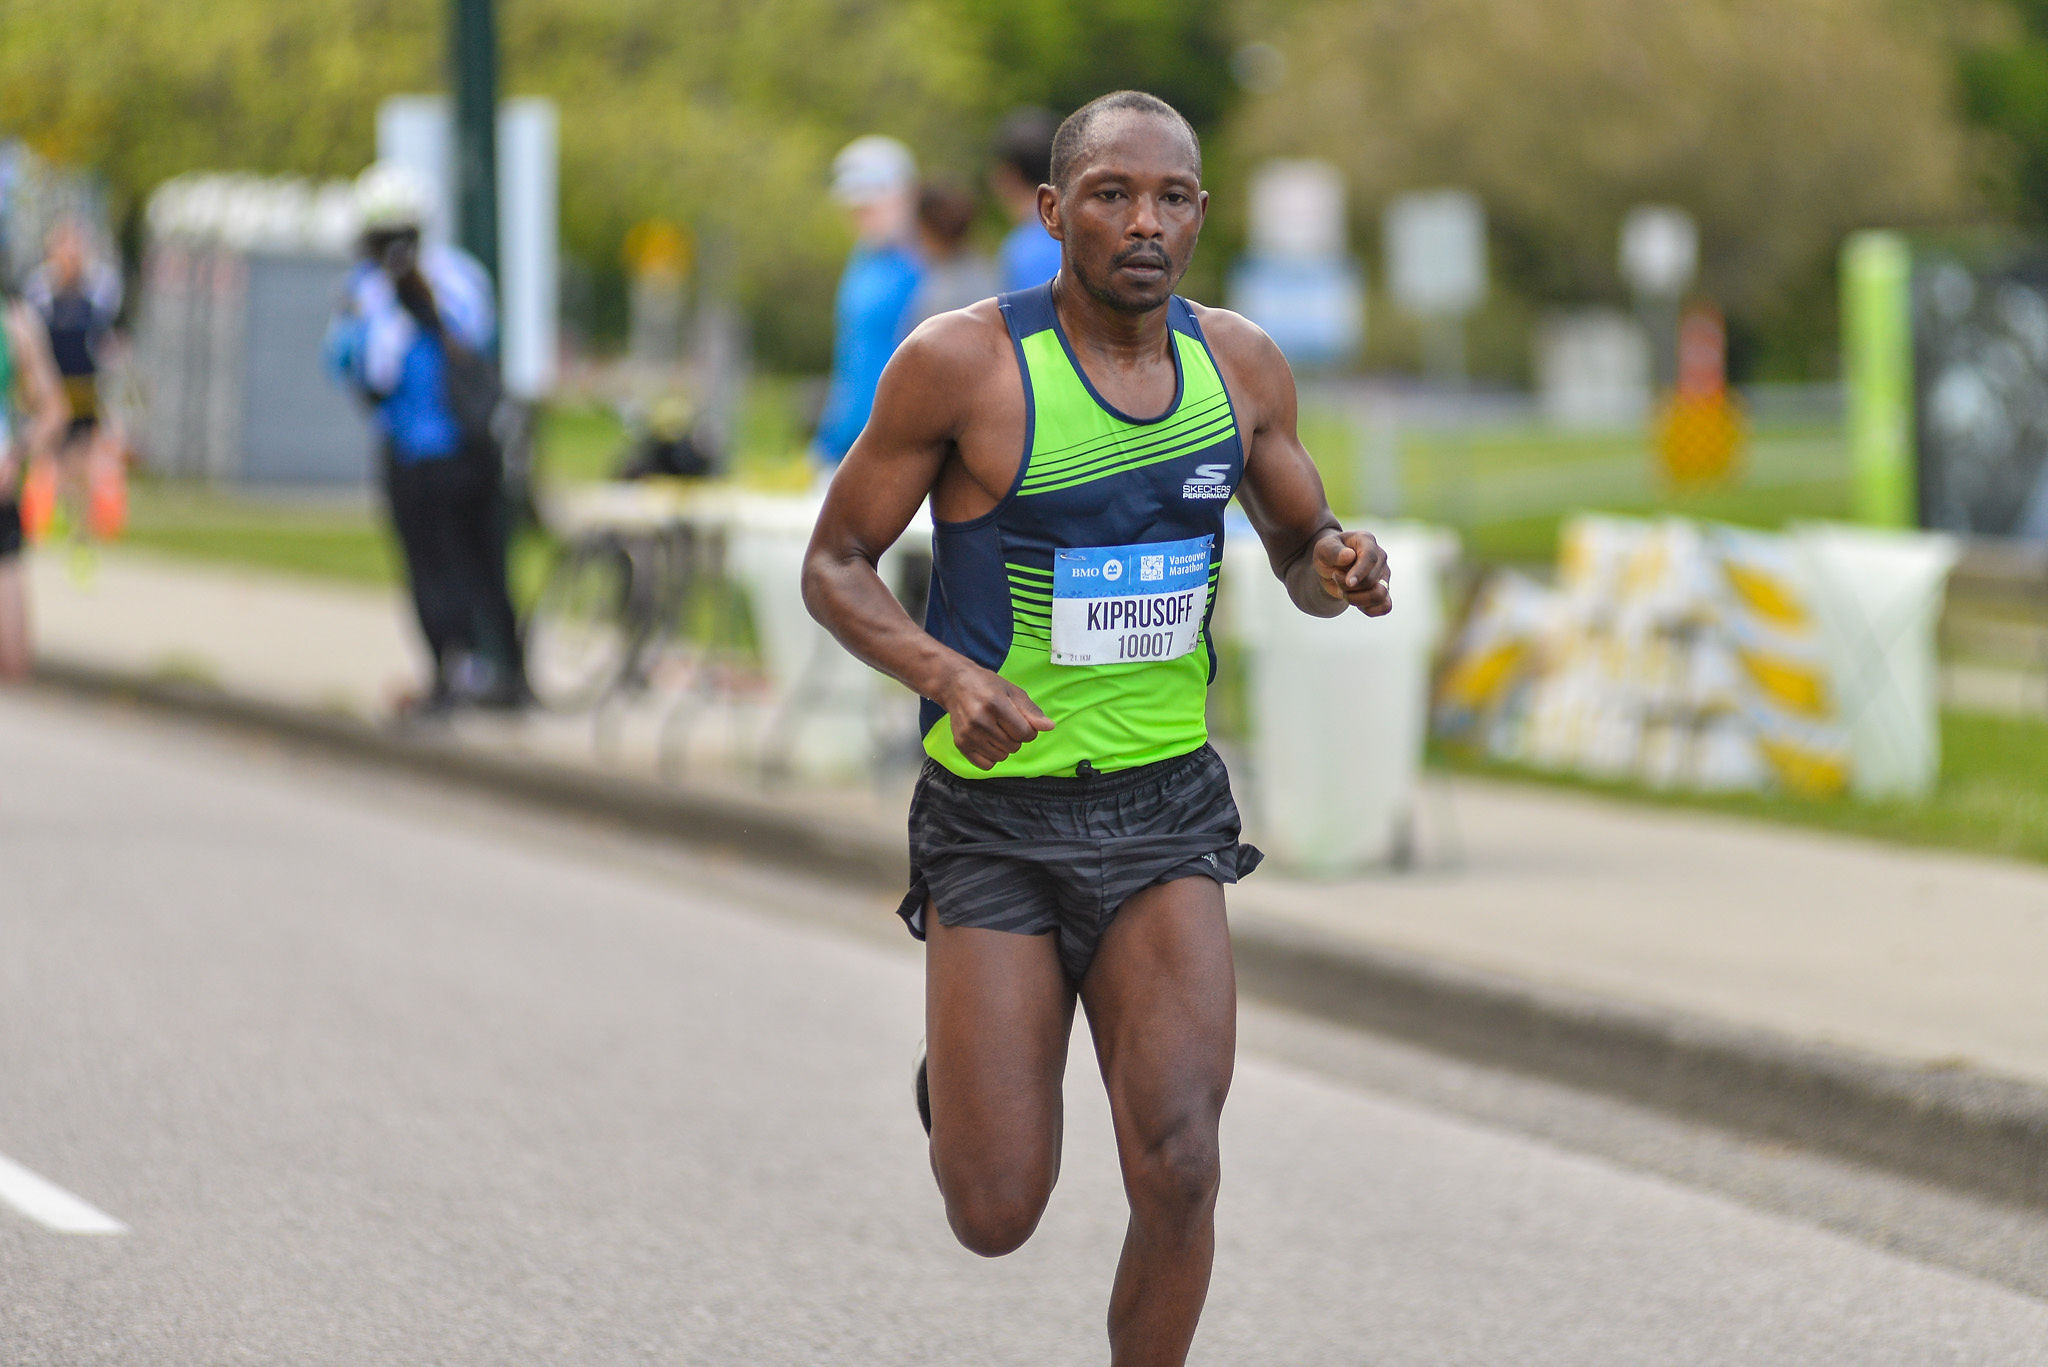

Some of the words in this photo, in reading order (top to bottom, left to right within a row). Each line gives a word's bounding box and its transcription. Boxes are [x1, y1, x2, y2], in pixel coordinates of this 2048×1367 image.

[1183, 485, 1231, 493] SKECHERS
[1169, 551, 1206, 565] Vancouver
[1072, 568, 1100, 577] BMO
[1169, 562, 1204, 576] Marathon
[1087, 593, 1194, 631] KIPRUSOFF
[1118, 632, 1174, 659] 10007
